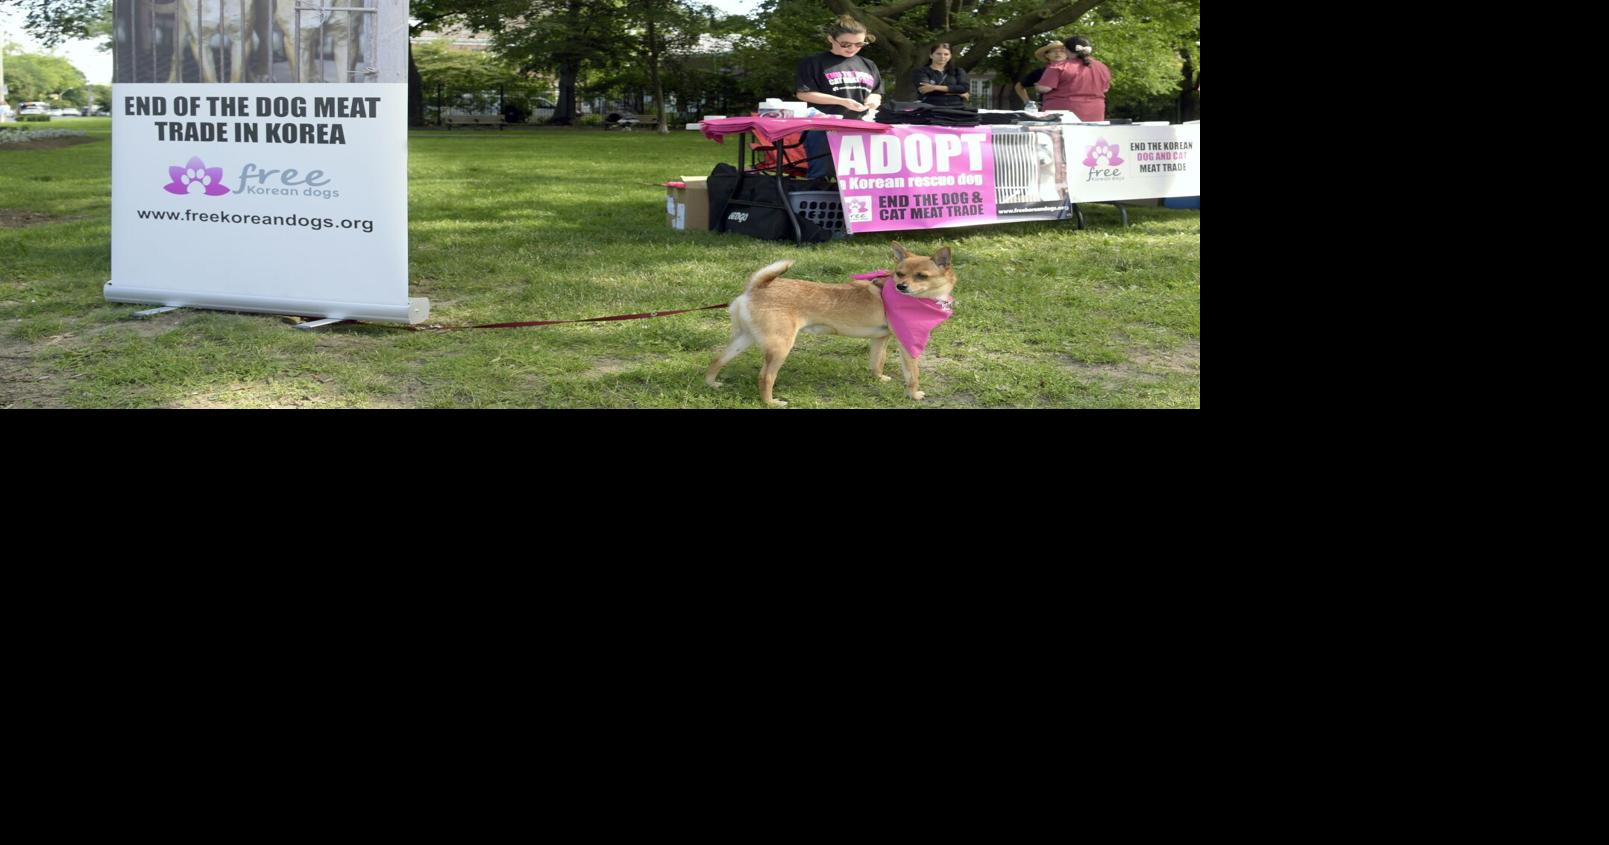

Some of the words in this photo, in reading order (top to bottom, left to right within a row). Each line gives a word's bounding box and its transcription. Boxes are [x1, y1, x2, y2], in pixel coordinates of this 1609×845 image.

[124, 96, 167, 116] END
[173, 96, 201, 117] OF
[205, 96, 250, 117] THE
[256, 96, 307, 119] DOG
[314, 97, 381, 118] MEAT
[154, 121, 228, 143] TRADE
[234, 122, 259, 143] IN
[265, 122, 346, 144] KOREA
[838, 133, 986, 175] ADOPT
[1130, 142, 1146, 151] END
[1148, 142, 1162, 151] THE
[1164, 141, 1193, 150] KOREAN
[1137, 152, 1154, 161] DOG
[1155, 152, 1171, 160] AND
[1173, 151, 1187, 160] CAT
[1086, 167, 1121, 182] free
[1140, 164, 1161, 173] MEAT
[1162, 163, 1187, 172] TRADE
[232, 163, 331, 195] free
[849, 177, 905, 190] Korean
[908, 175, 955, 188] rescue
[957, 173, 983, 186] dog
[247, 185, 299, 196] Korean
[303, 187, 340, 199] dogs
[879, 195, 909, 208] END
[913, 194, 938, 207] THE
[941, 192, 968, 206] DOG
[971, 191, 983, 204] &
[137, 209, 374, 233] www.freekoreandogs.org
[879, 208, 906, 221] CAT
[910, 207, 943, 220] MEAT
[946, 204, 984, 217] TRADE
